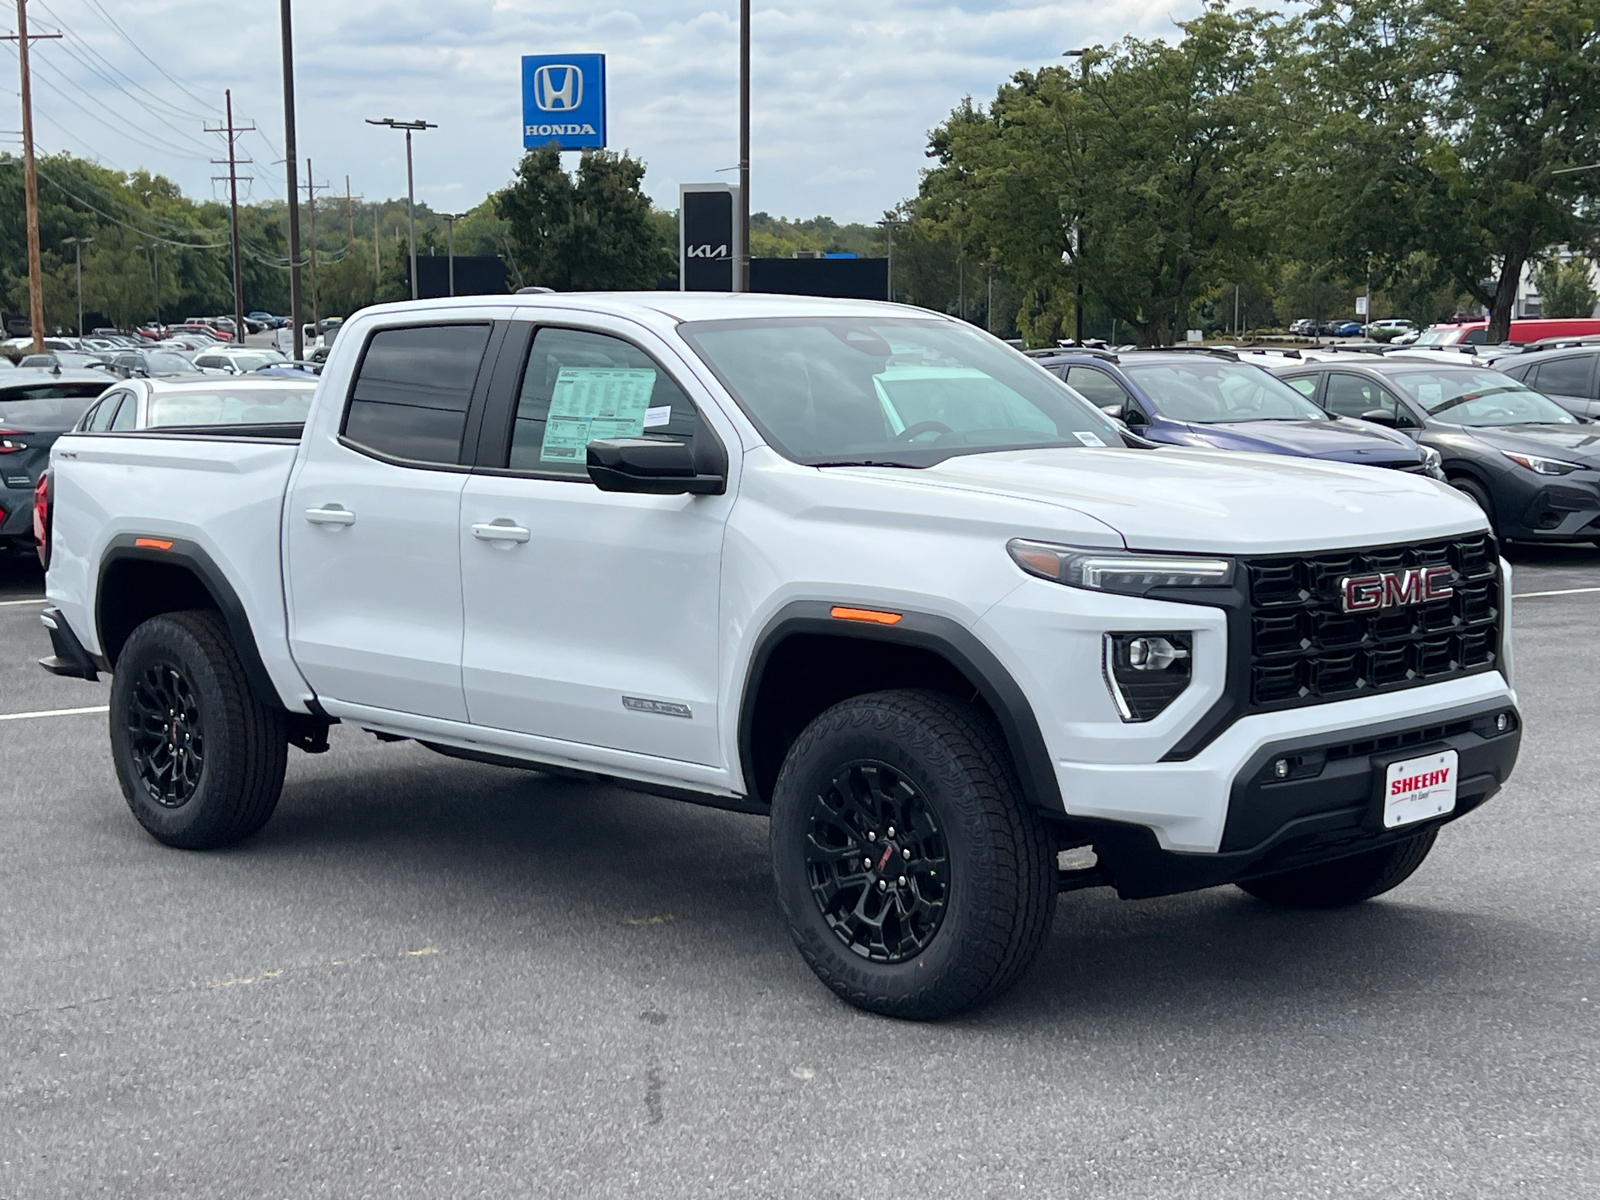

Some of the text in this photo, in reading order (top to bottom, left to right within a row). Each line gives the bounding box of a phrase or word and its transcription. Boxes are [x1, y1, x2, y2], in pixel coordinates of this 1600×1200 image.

[525, 124, 596, 136] HONDA
[687, 244, 727, 258] KIA
[1341, 565, 1453, 613] GMC
[1391, 767, 1450, 795] SHEEHY
